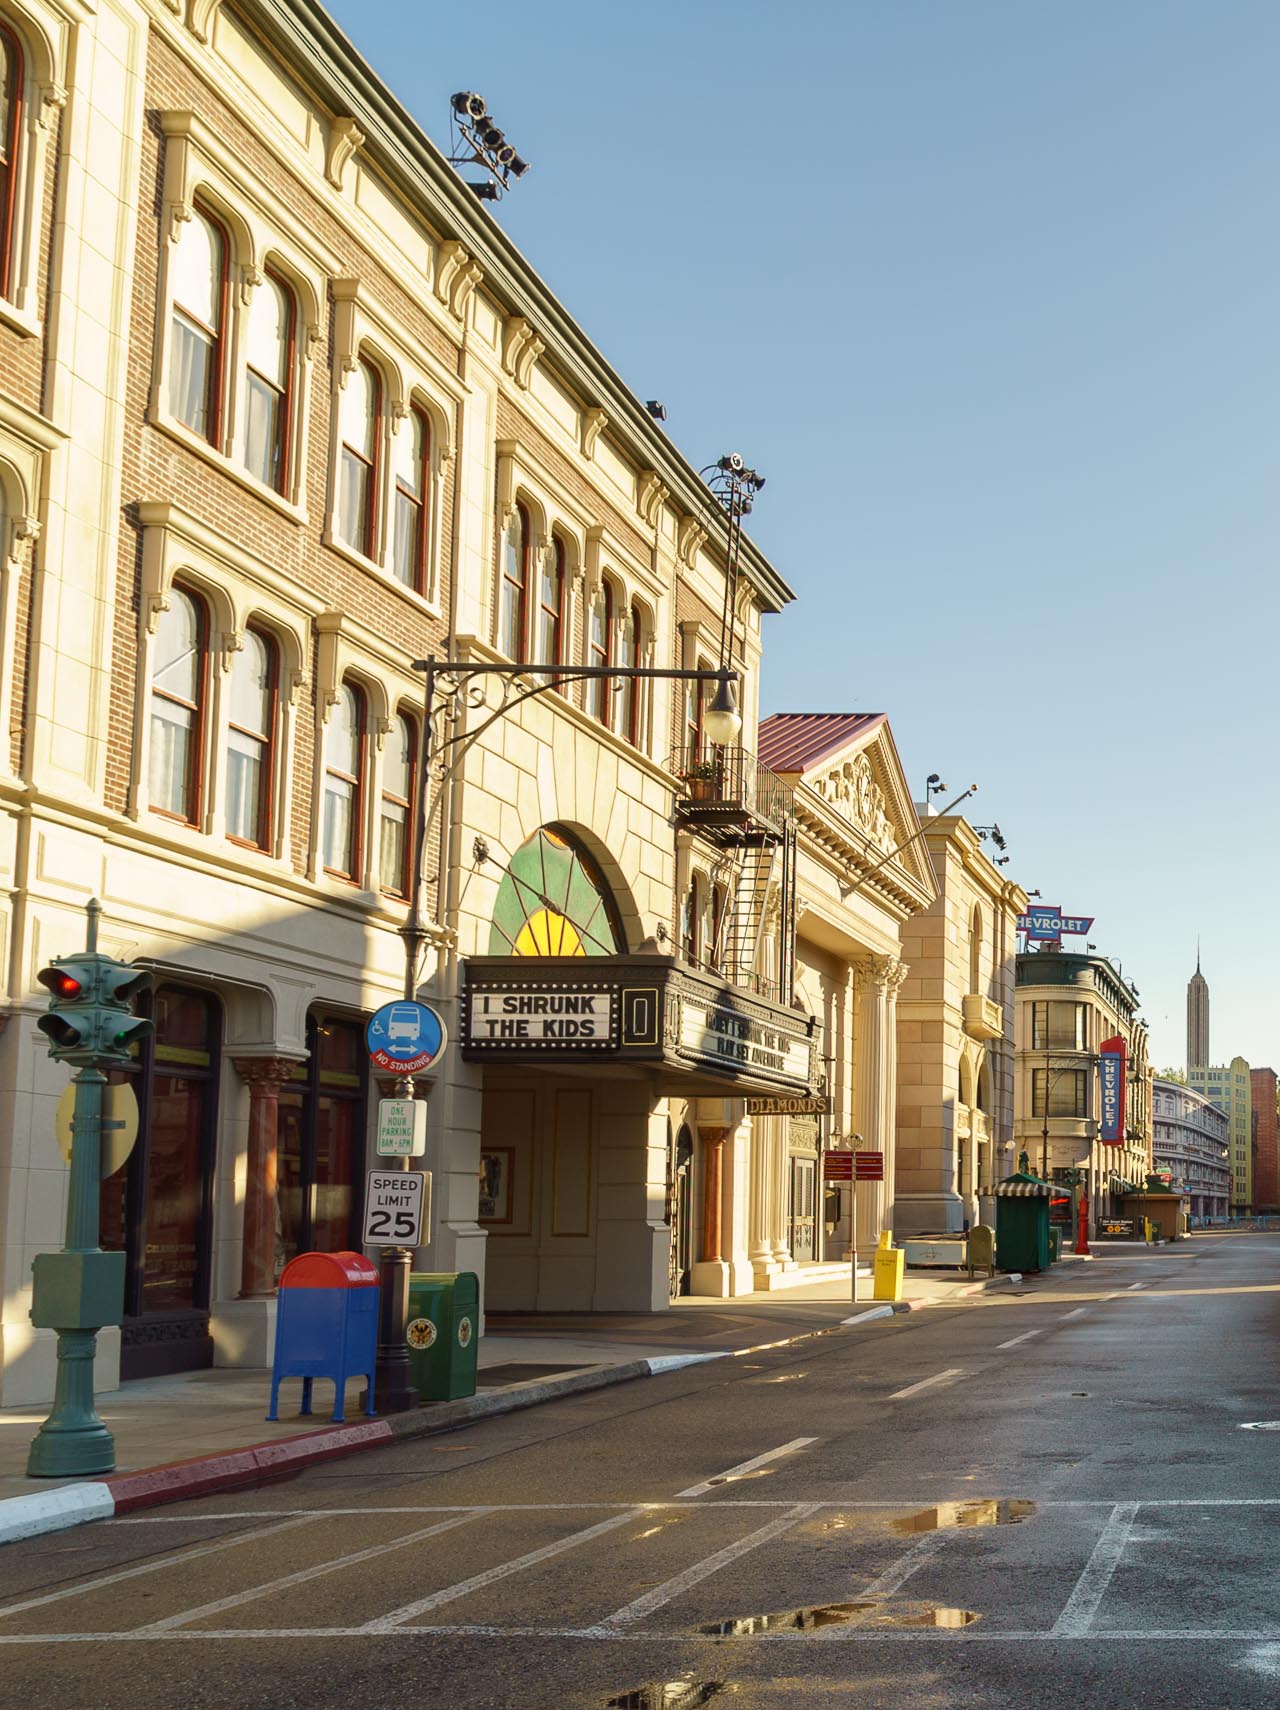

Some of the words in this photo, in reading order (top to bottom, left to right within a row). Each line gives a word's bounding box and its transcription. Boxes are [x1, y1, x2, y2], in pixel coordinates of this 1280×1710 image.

[1016, 917, 1082, 931] HEVROLET
[483, 996, 490, 1014] I
[502, 996, 595, 1014] SHRUNK
[486, 1019, 529, 1037] THE
[543, 1019, 595, 1038] KIDS
[376, 1053, 389, 1065] NO
[389, 1055, 430, 1070] STANDING
[1104, 1059, 1116, 1127] CHEVROLET
[391, 1106, 404, 1116] ONE
[750, 1098, 826, 1113] DIAMONDS
[388, 1117, 407, 1126] HOUR
[381, 1127, 412, 1137] PARKING
[373, 1179, 418, 1191] SPEED
[377, 1195, 412, 1206] LIMIT
[368, 1211, 415, 1238] 25
